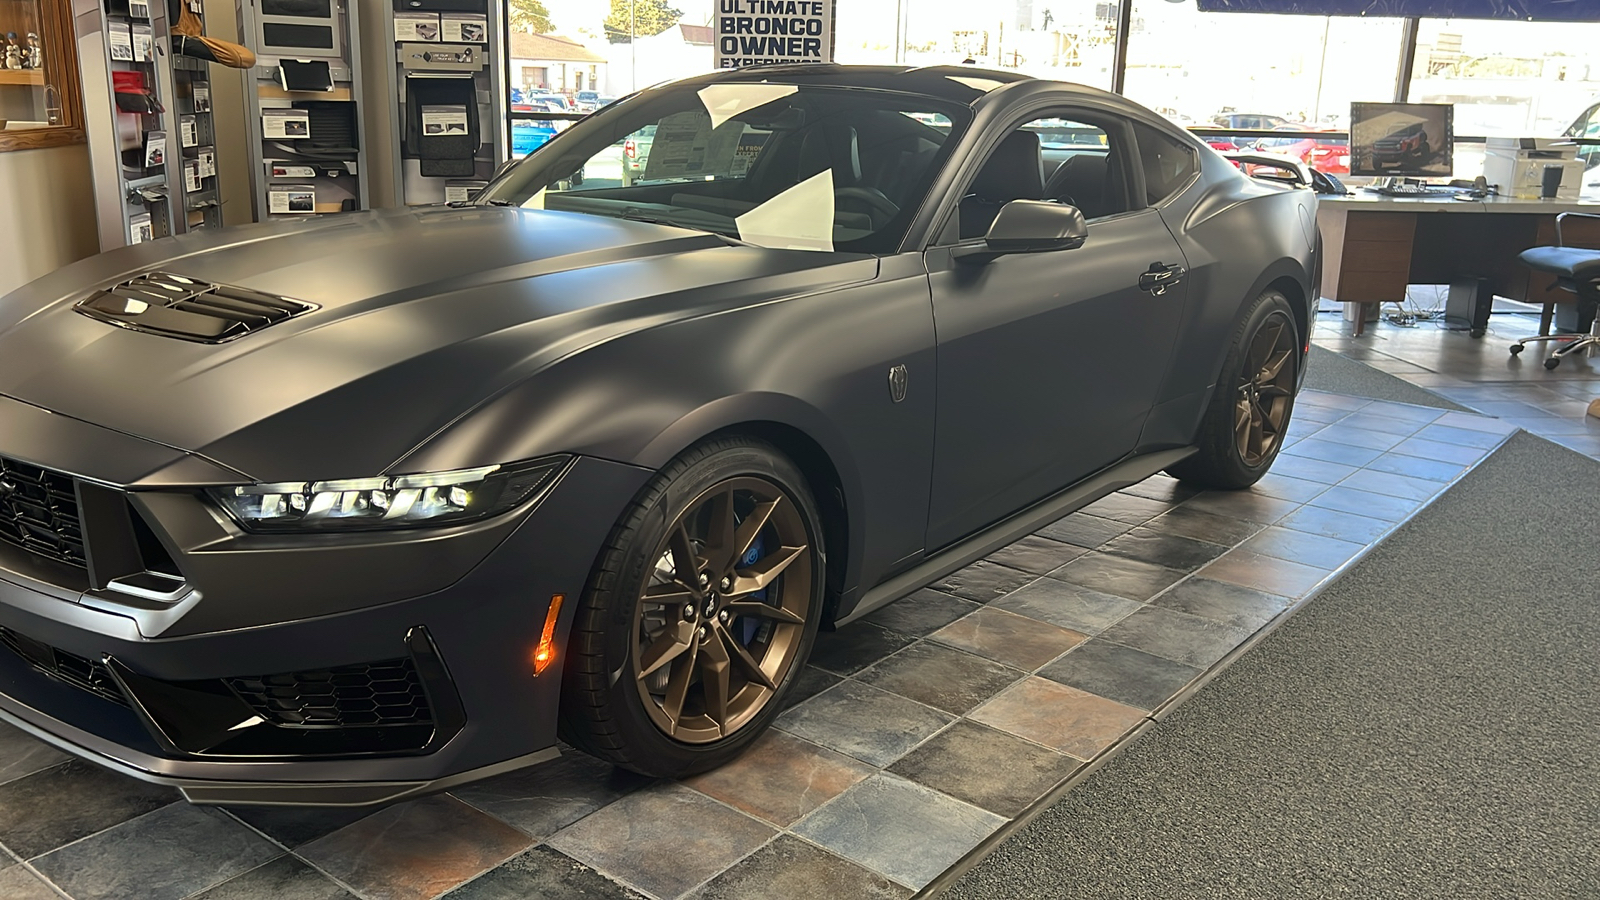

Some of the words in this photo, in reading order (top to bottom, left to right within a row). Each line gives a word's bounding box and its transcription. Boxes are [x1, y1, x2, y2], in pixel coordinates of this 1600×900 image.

[720, 0, 822, 15] ULTIMATE
[720, 17, 822, 36] BRONCO
[720, 36, 821, 57] OWNER
[720, 58, 821, 68] EXPER
